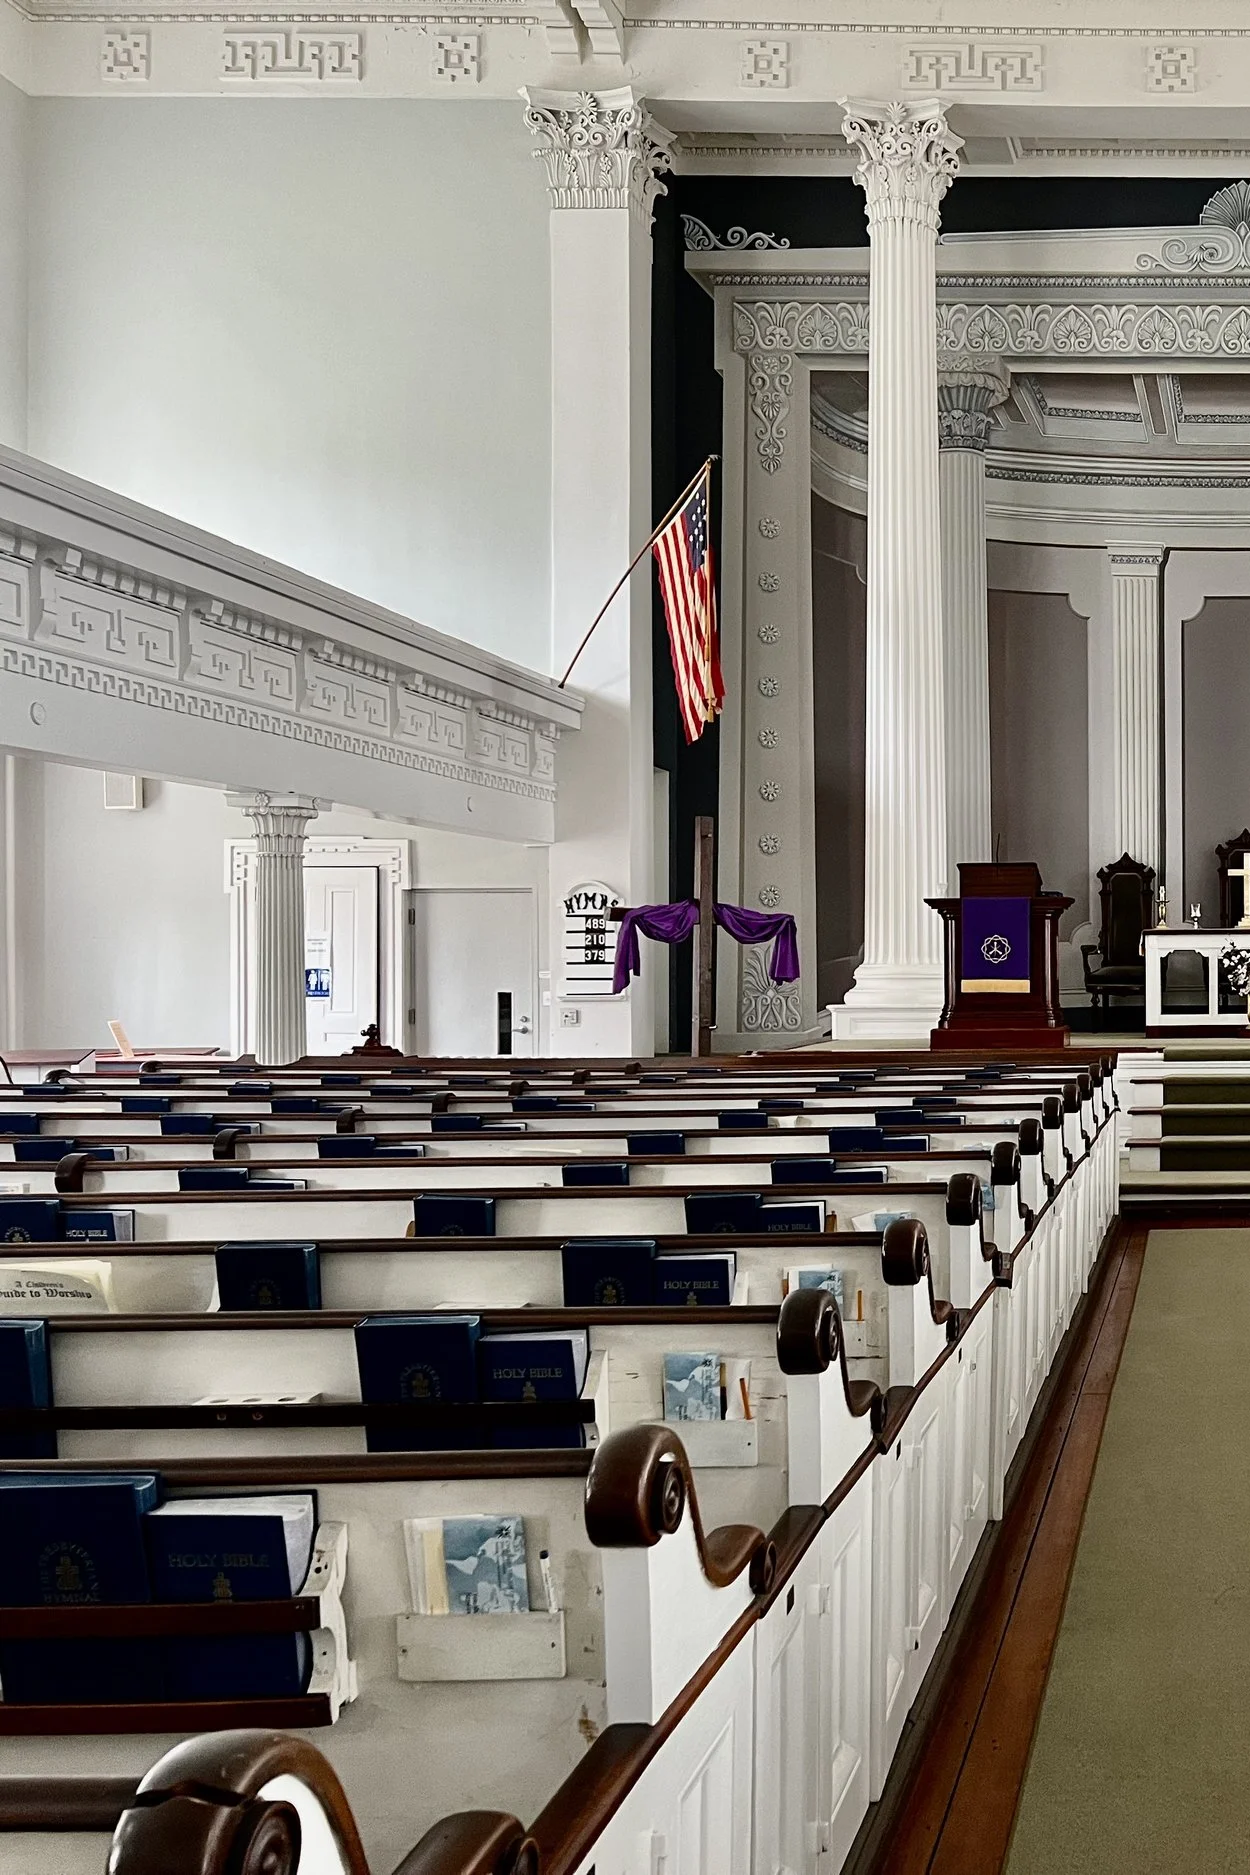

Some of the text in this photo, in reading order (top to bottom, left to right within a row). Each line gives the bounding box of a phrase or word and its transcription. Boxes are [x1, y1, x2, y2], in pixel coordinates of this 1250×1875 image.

[585, 918, 606, 929] 489
[585, 934, 605, 945] 210
[585, 949, 605, 961] 379
[767, 1222, 813, 1232] HOLY BIBLE
[65, 1229, 108, 1238] HOLY BIBLE
[663, 1279, 720, 1290] HOLY BIBLE
[0, 1288, 92, 1299] uide to Worship
[493, 1367, 563, 1379] HOLY BIBLE
[167, 1552, 270, 1568] HOLY BIBLE
